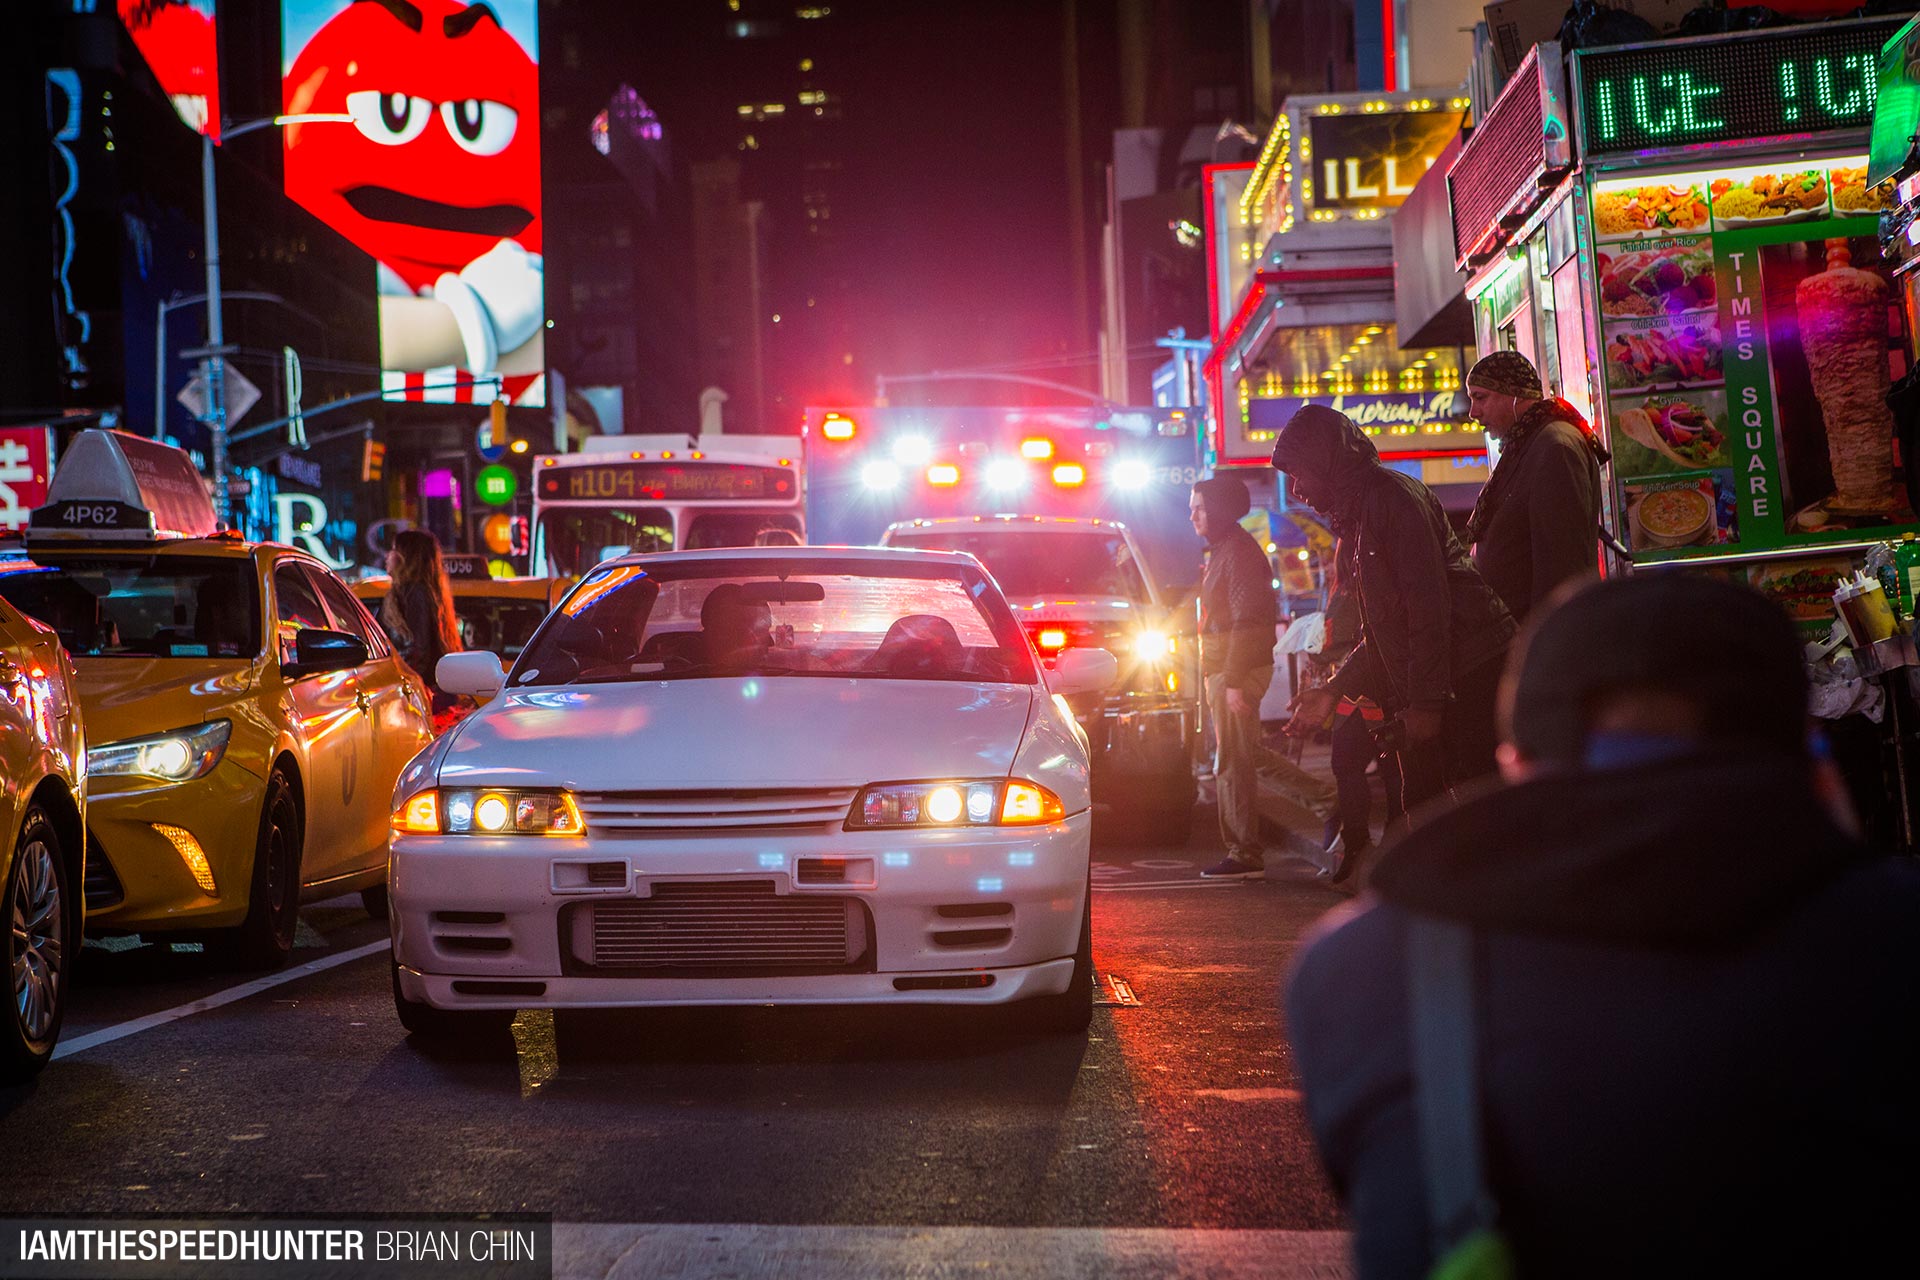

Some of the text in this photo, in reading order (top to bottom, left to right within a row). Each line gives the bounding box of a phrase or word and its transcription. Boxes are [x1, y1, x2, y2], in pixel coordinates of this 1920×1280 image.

[1323, 157, 1431, 199] ILL
[1654, 241, 1673, 249] over
[1676, 238, 1697, 247] Rice
[1728, 252, 1770, 518] TIMES SQUARE
[487, 477, 506, 493] m
[569, 469, 634, 498] M104
[1679, 480, 1700, 490] Soup
[63, 505, 117, 524] 4P62
[272, 492, 355, 570] R
